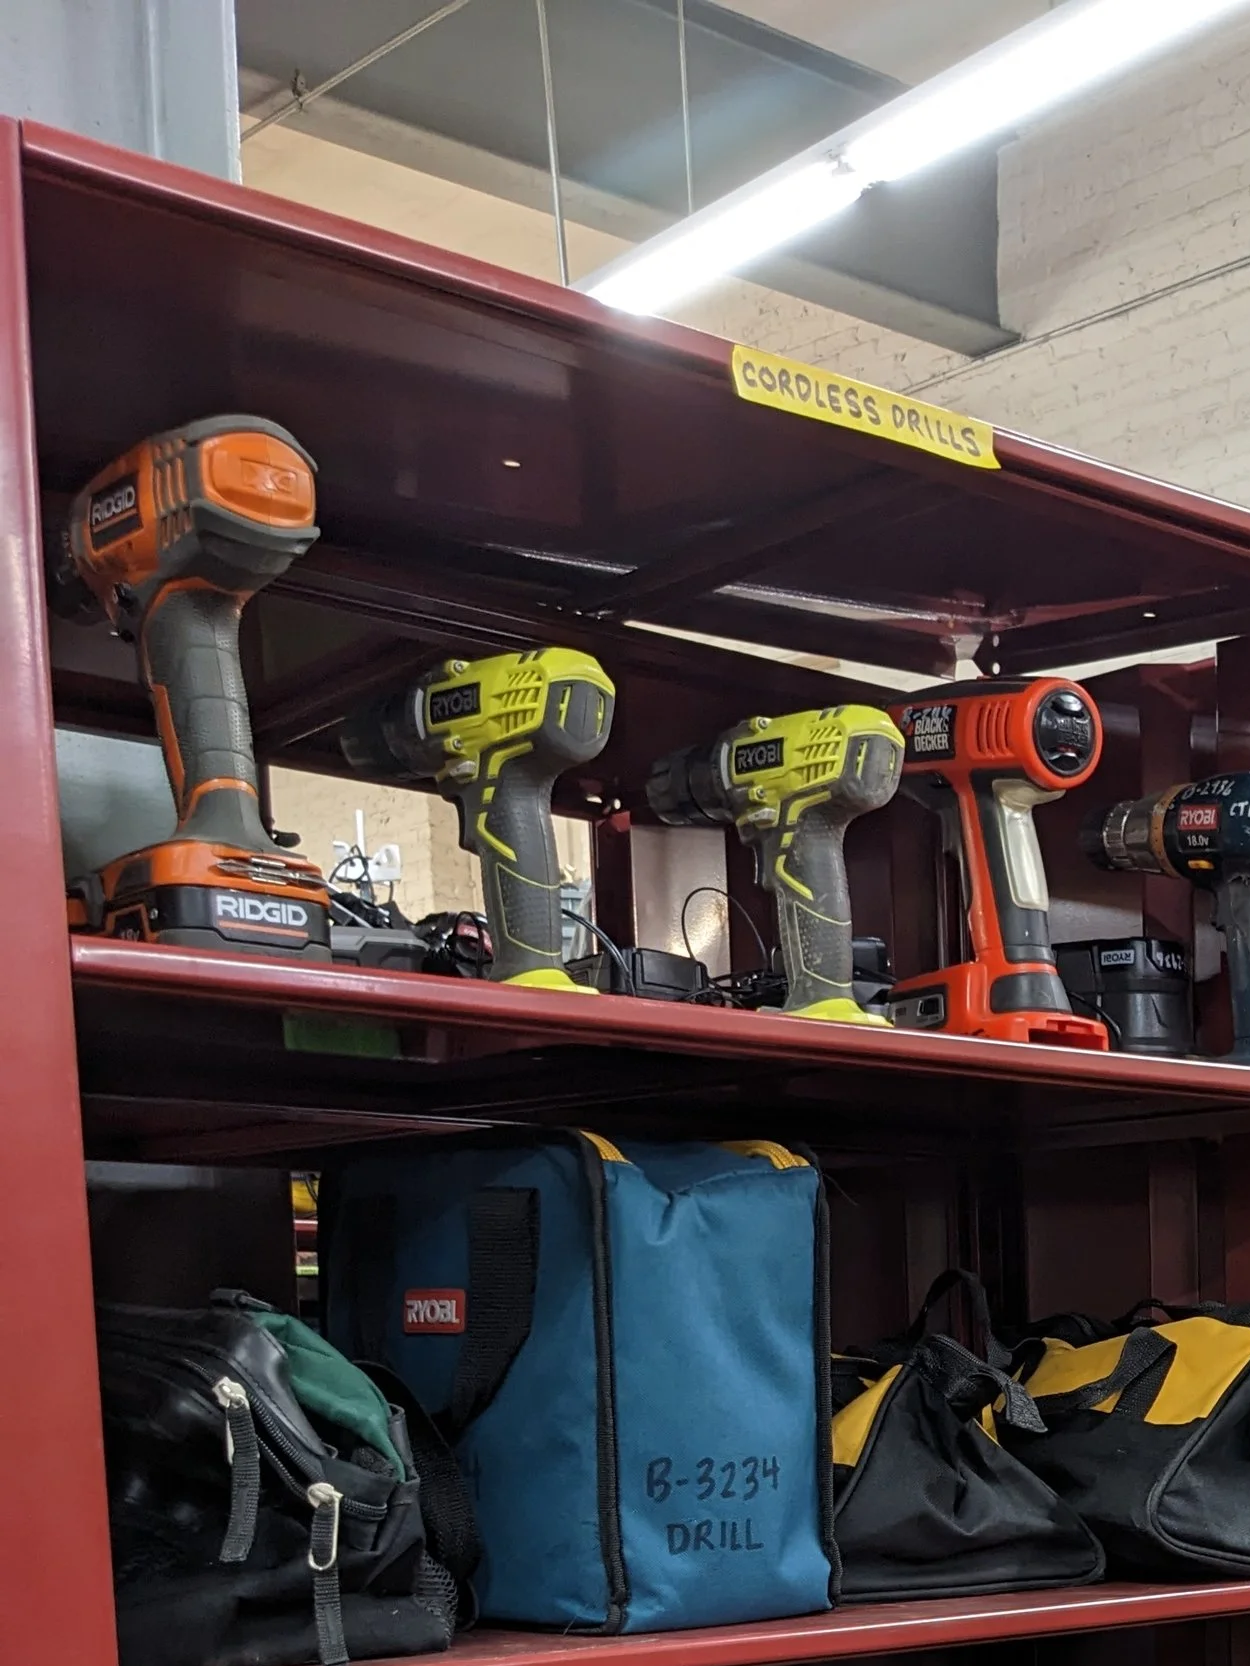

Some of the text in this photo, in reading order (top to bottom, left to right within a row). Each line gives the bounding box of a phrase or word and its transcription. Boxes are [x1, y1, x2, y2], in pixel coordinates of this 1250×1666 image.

[742, 361, 981, 457] CORDLESS DRILLS
[92, 486, 136, 525] RIDGID
[432, 686, 478, 718] RYOBI
[736, 740, 780, 769] RYOBI
[914, 733, 949, 752] DECKER
[1180, 808, 1216, 827] RYOBI
[216, 895, 308, 926] RIDGID
[1102, 951, 1132, 963] RYOBI
[646, 1455, 781, 1503] B-3234
[667, 1519, 765, 1555] DRILL
